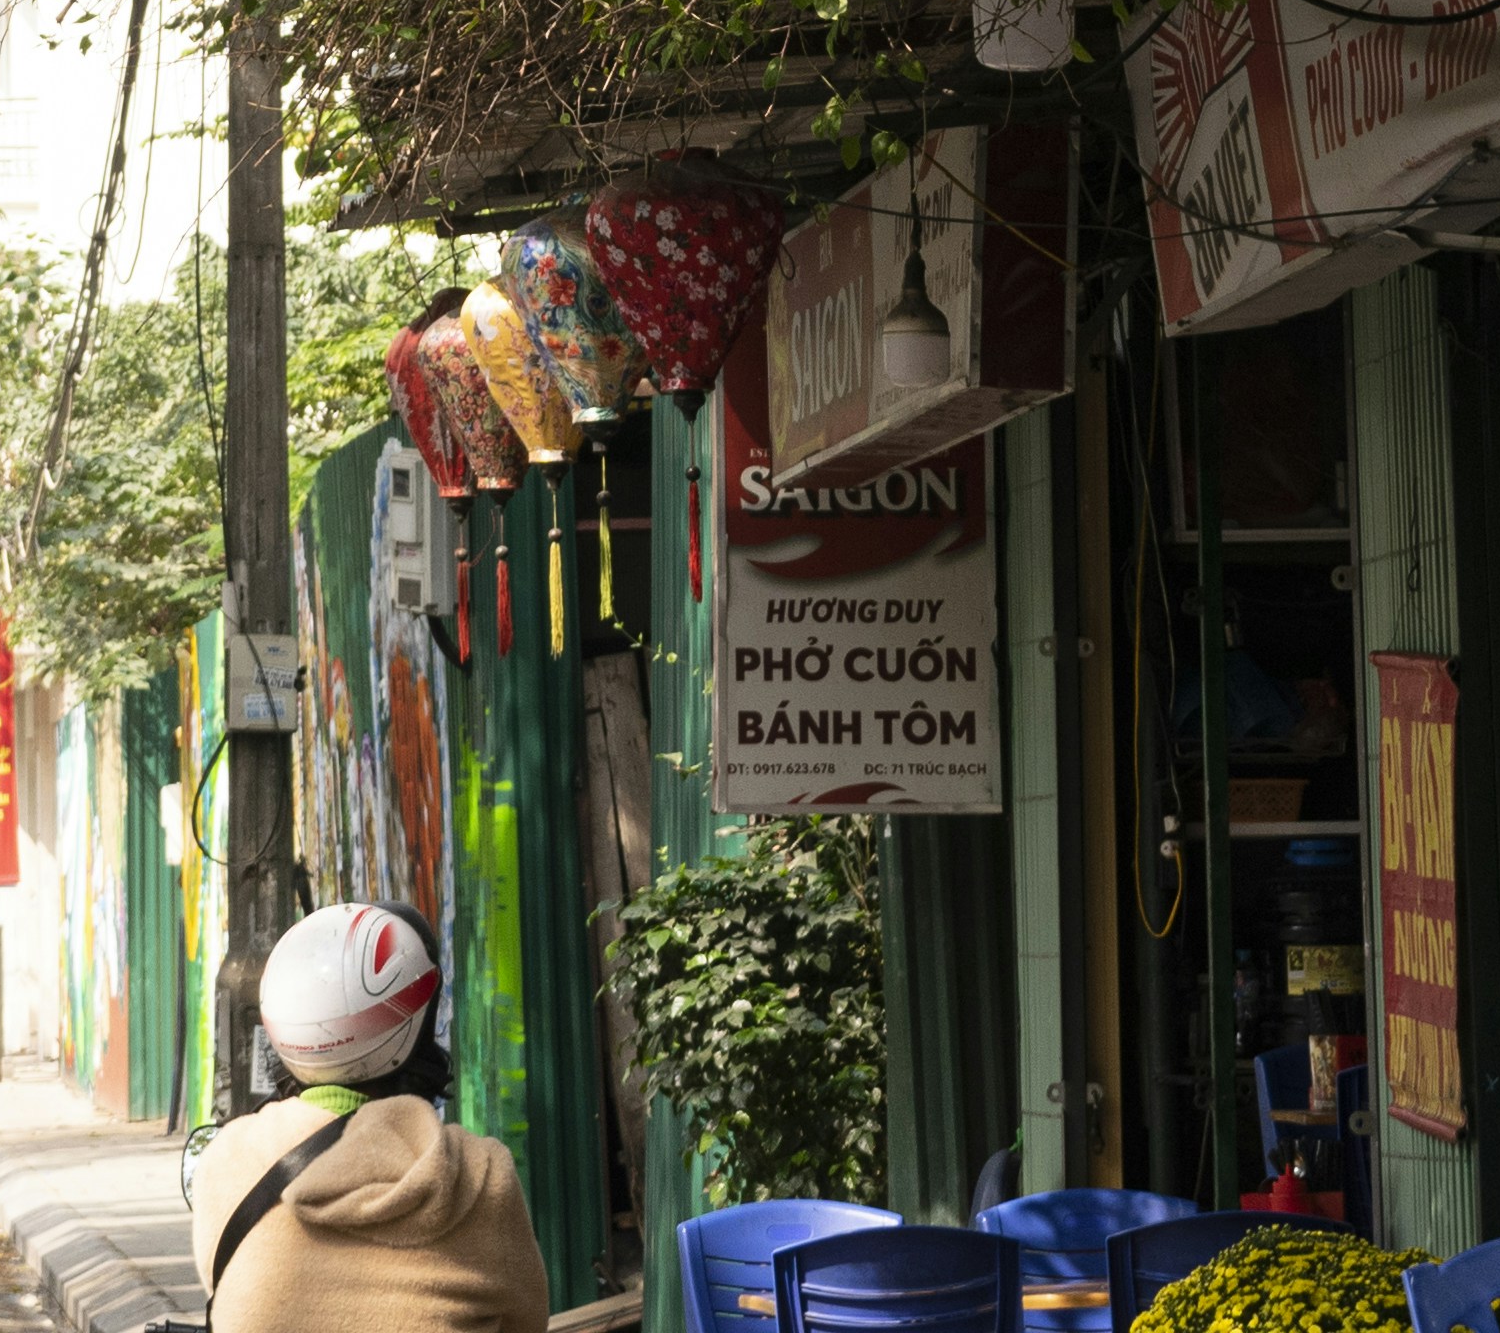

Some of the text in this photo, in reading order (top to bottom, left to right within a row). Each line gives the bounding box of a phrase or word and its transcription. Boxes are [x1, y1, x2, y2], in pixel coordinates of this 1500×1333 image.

[1305, 22, 1347, 160] PHỞ
[766, 597, 944, 623] HƯƠNG DUY
[735, 635, 977, 682] PHỞ CUỐN
[737, 699, 976, 745] BÁNH TÔM
[753, 762, 836, 775] 0917.623.678
[892, 763, 904, 775] 71
[908, 760, 944, 776] TRÚC
